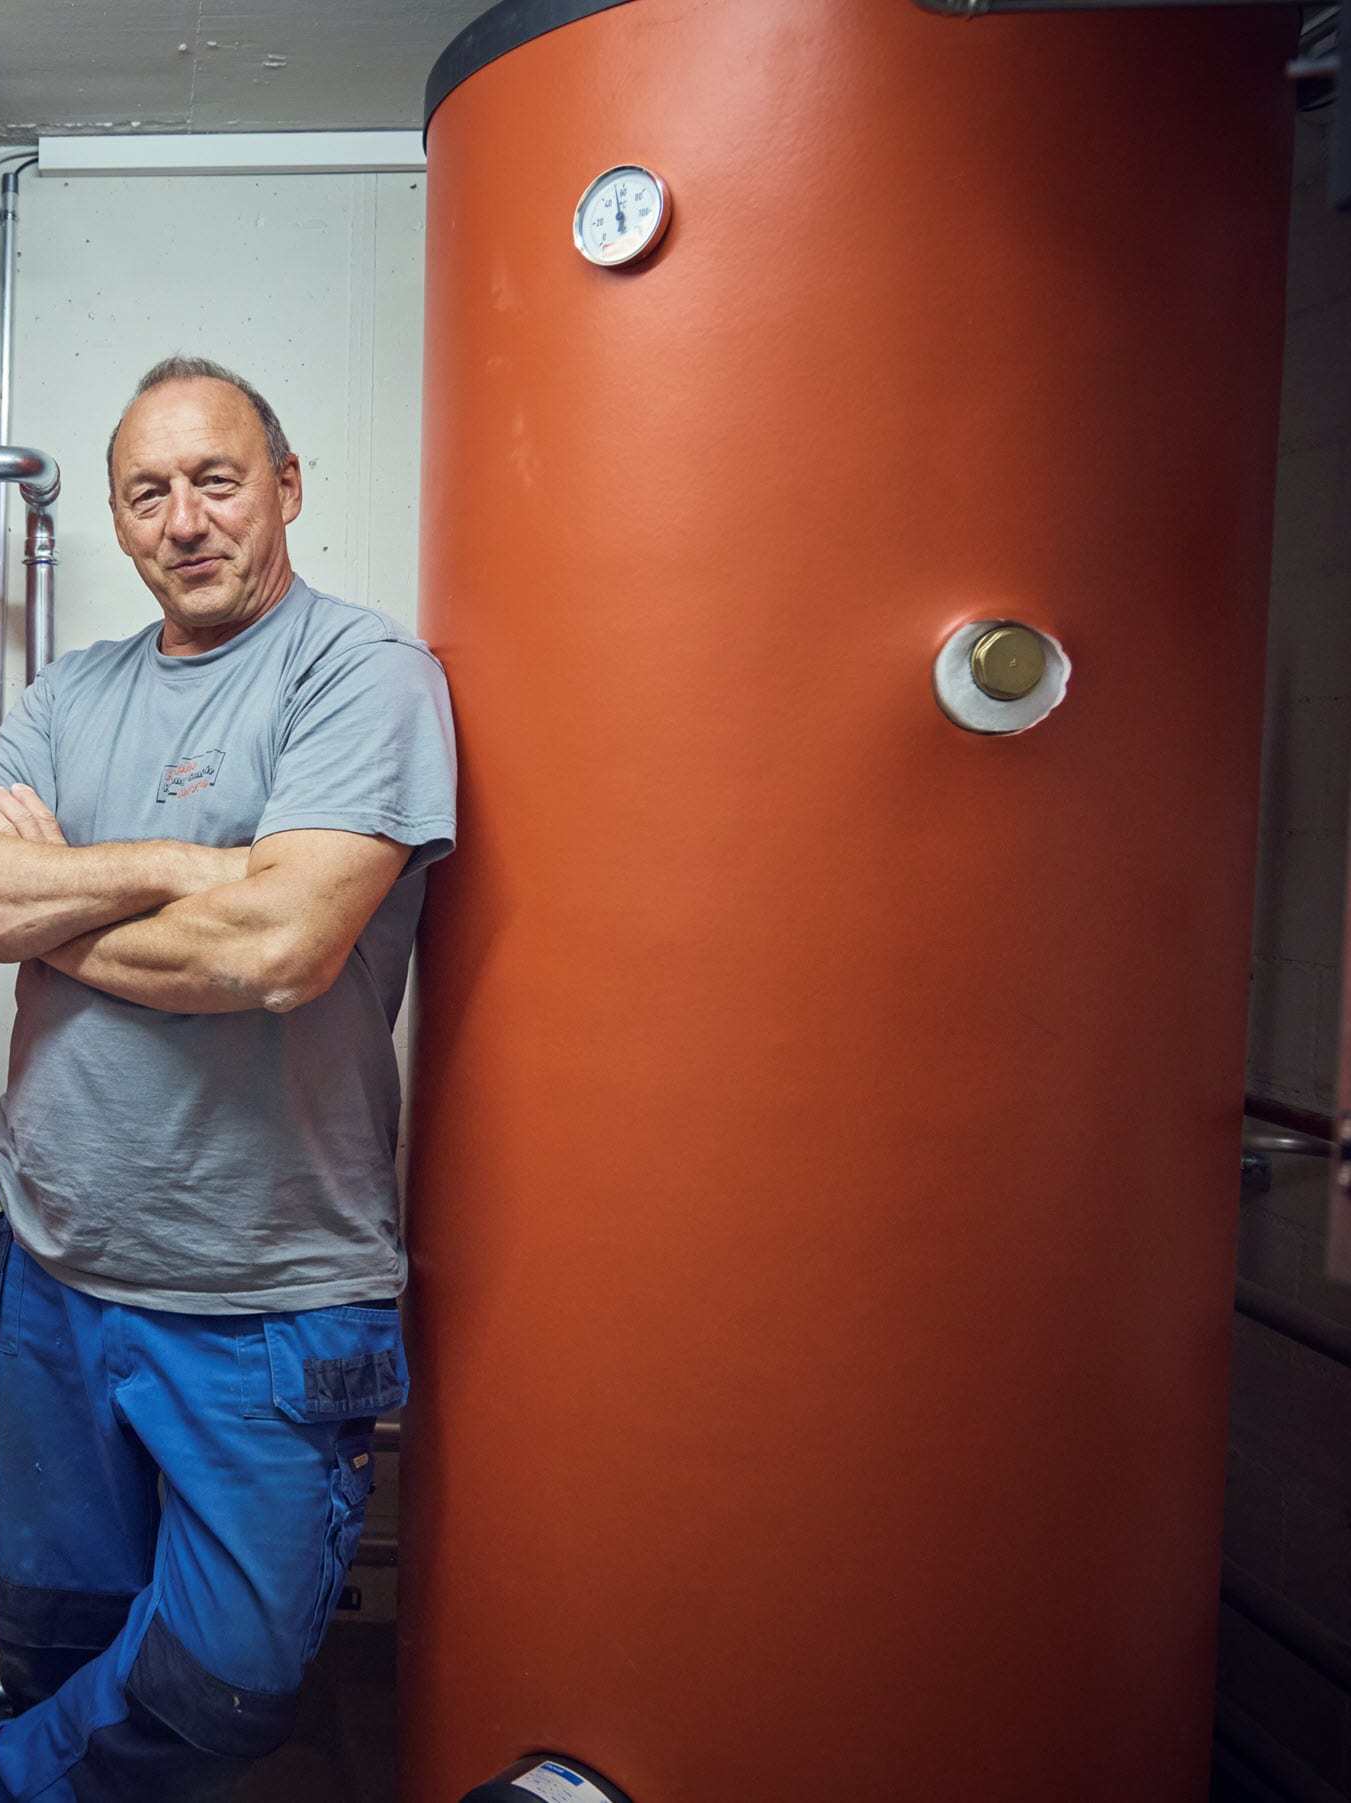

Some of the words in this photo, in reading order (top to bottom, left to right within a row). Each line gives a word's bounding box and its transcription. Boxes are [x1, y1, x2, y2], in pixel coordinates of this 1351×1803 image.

[620, 188, 627, 197] 60
[634, 192, 643, 201] 80
[604, 200, 612, 208] 40
[638, 207, 649, 217] 100
[596, 218, 604, 227] 20
